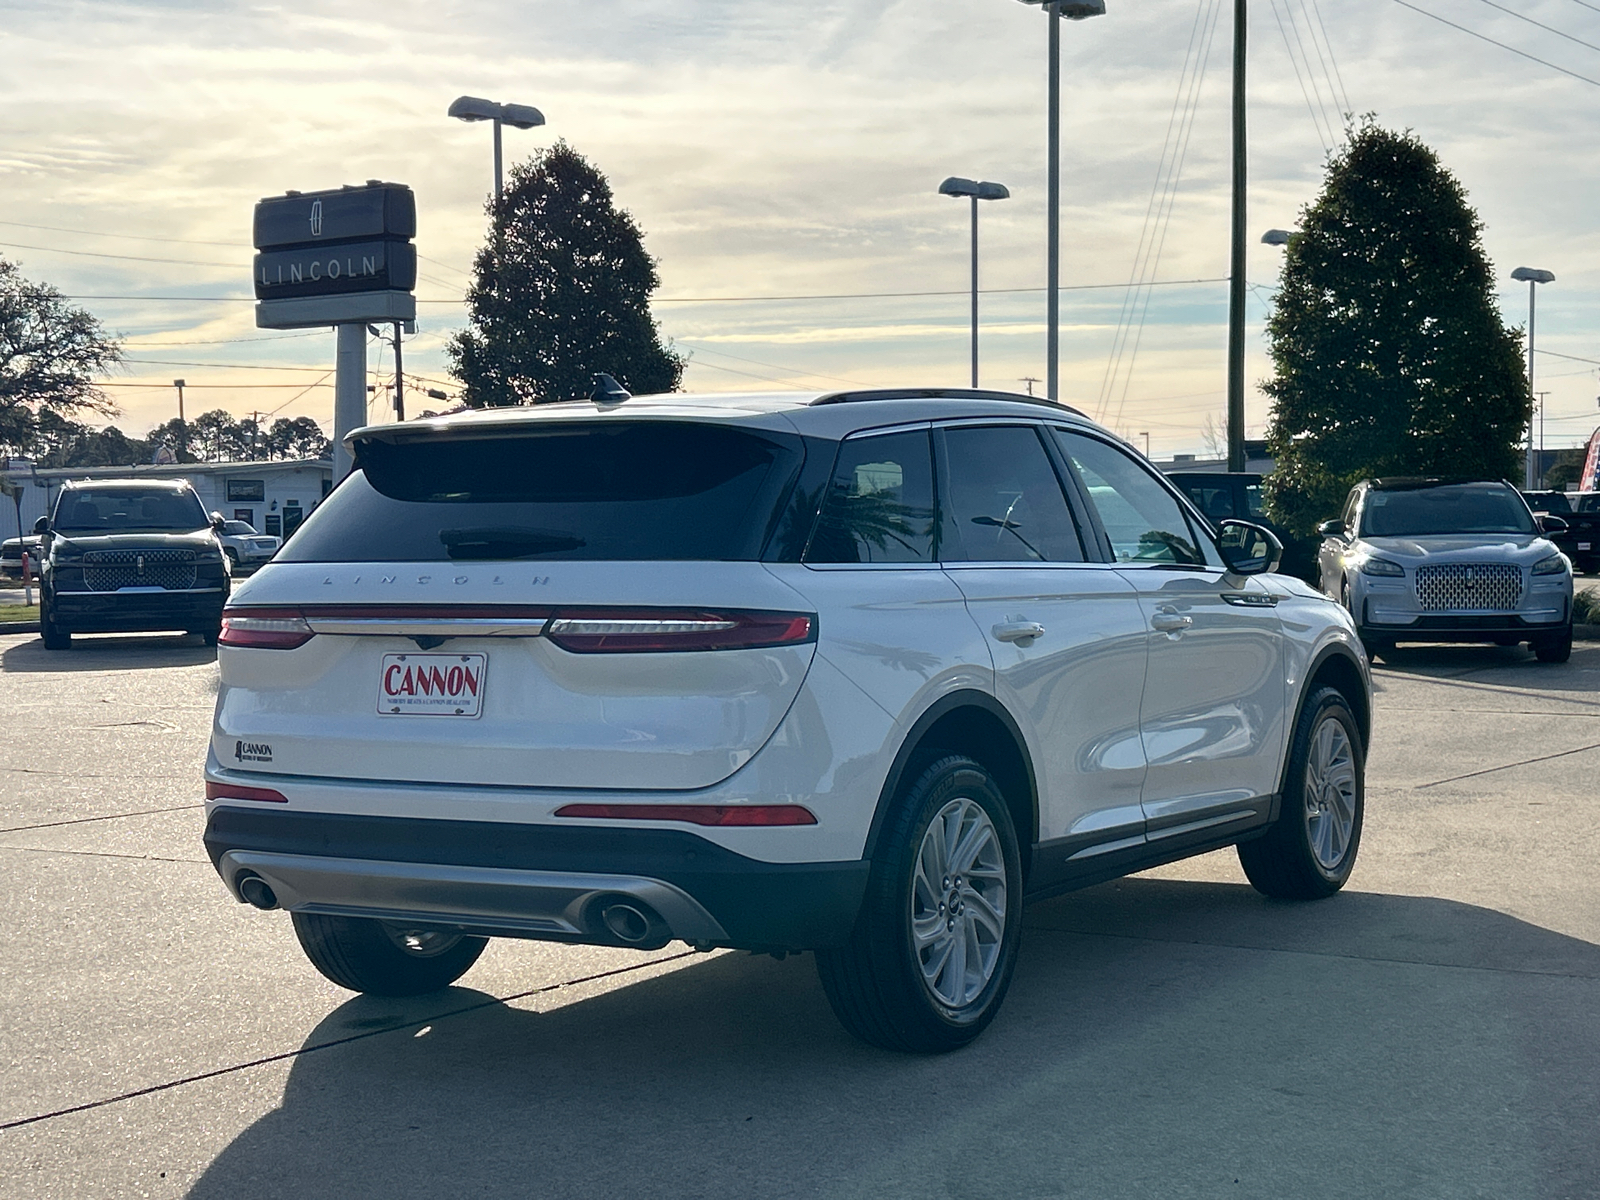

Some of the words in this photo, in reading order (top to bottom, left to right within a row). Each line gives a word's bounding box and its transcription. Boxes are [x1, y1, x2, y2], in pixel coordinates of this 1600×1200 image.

[262, 256, 375, 285] LINCOLN
[322, 575, 550, 586] LINCOLN
[384, 664, 480, 696] CANNON
[243, 743, 272, 755] CANNON
